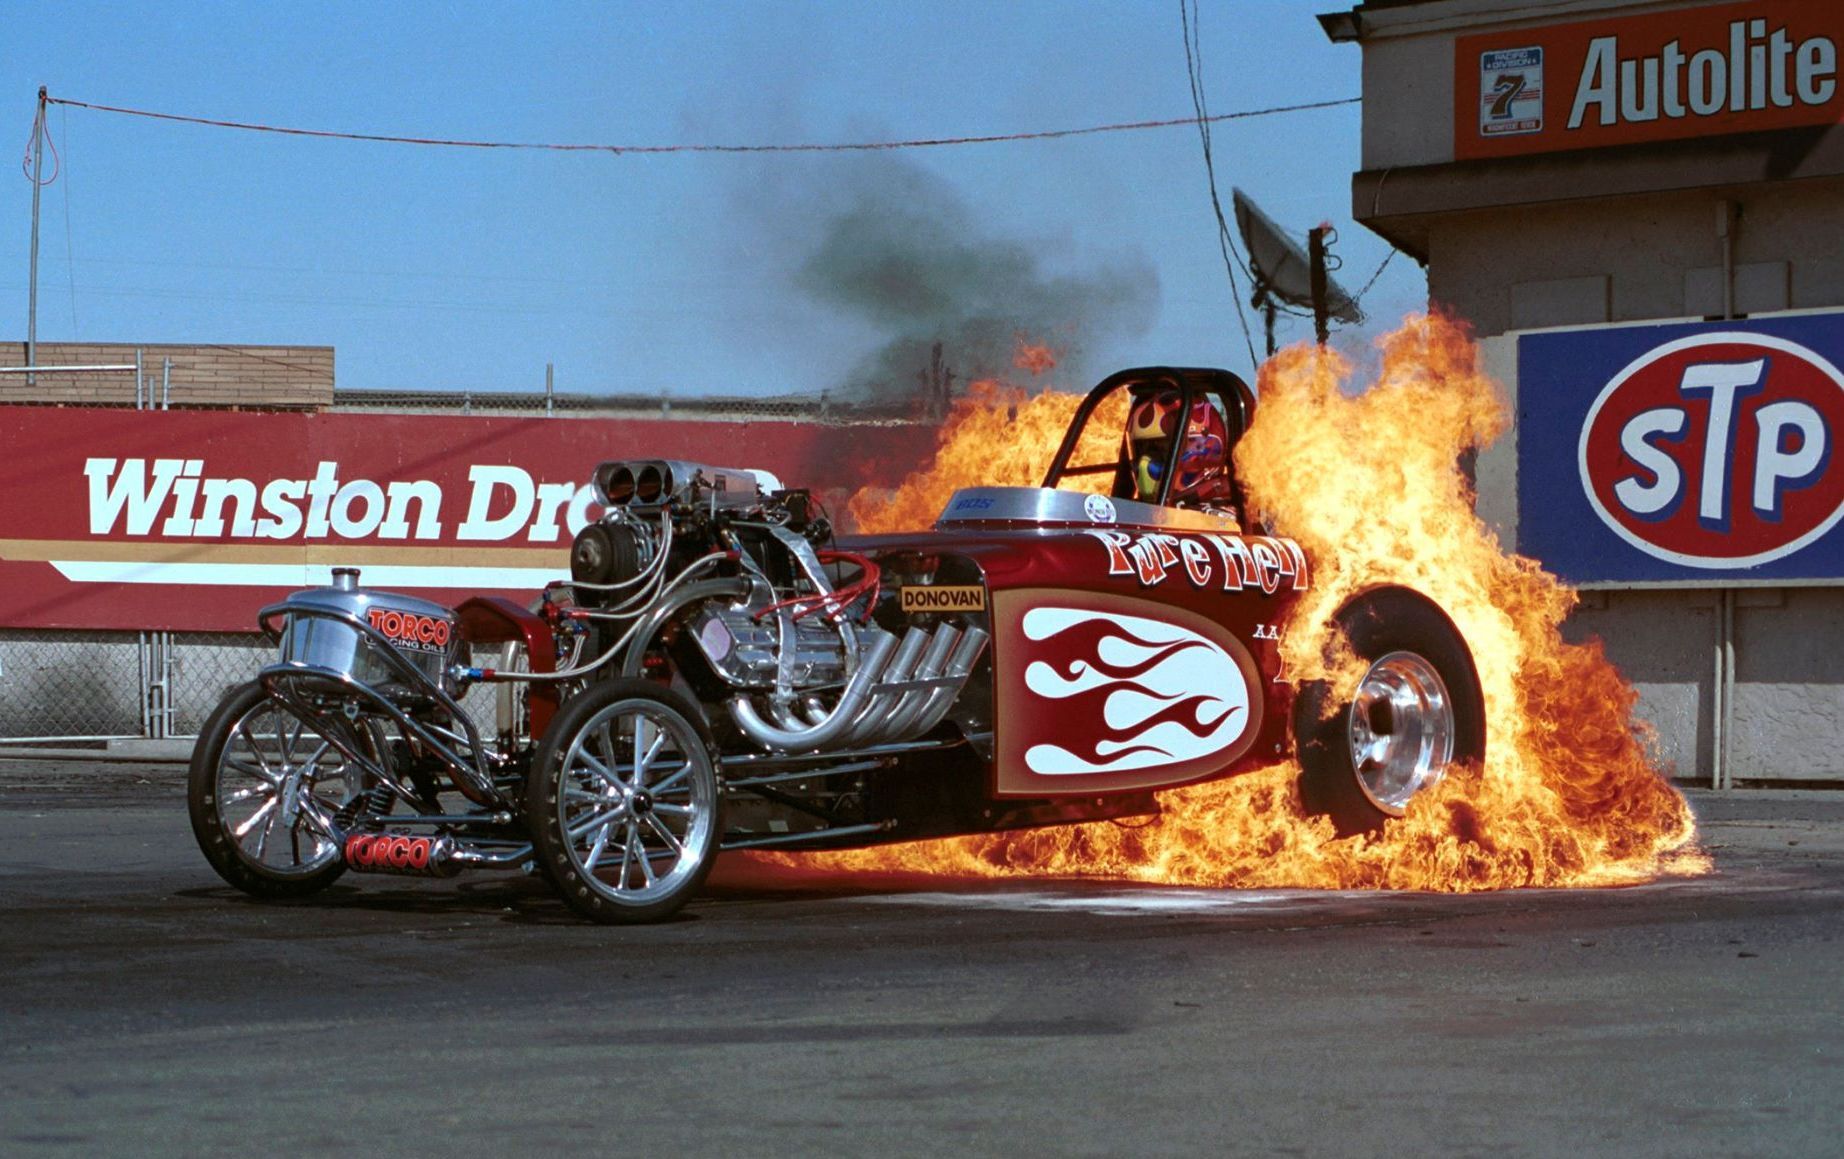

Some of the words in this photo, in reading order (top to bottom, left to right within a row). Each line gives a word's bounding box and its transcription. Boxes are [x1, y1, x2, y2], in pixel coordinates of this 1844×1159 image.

[1492, 58, 1532, 69] DIVISION
[1566, 17, 1837, 130] Autolite
[1490, 73, 1527, 119] 7
[1614, 357, 1829, 525] STP
[83, 457, 441, 540] Winston
[1084, 531, 1212, 587] Pure
[1201, 533, 1309, 595] Hell
[903, 589, 983, 607] DONOVAN
[368, 609, 450, 647] TORCO
[389, 637, 420, 650] CING
[422, 643, 446, 654] OILS
[345, 833, 431, 869] TORCO
